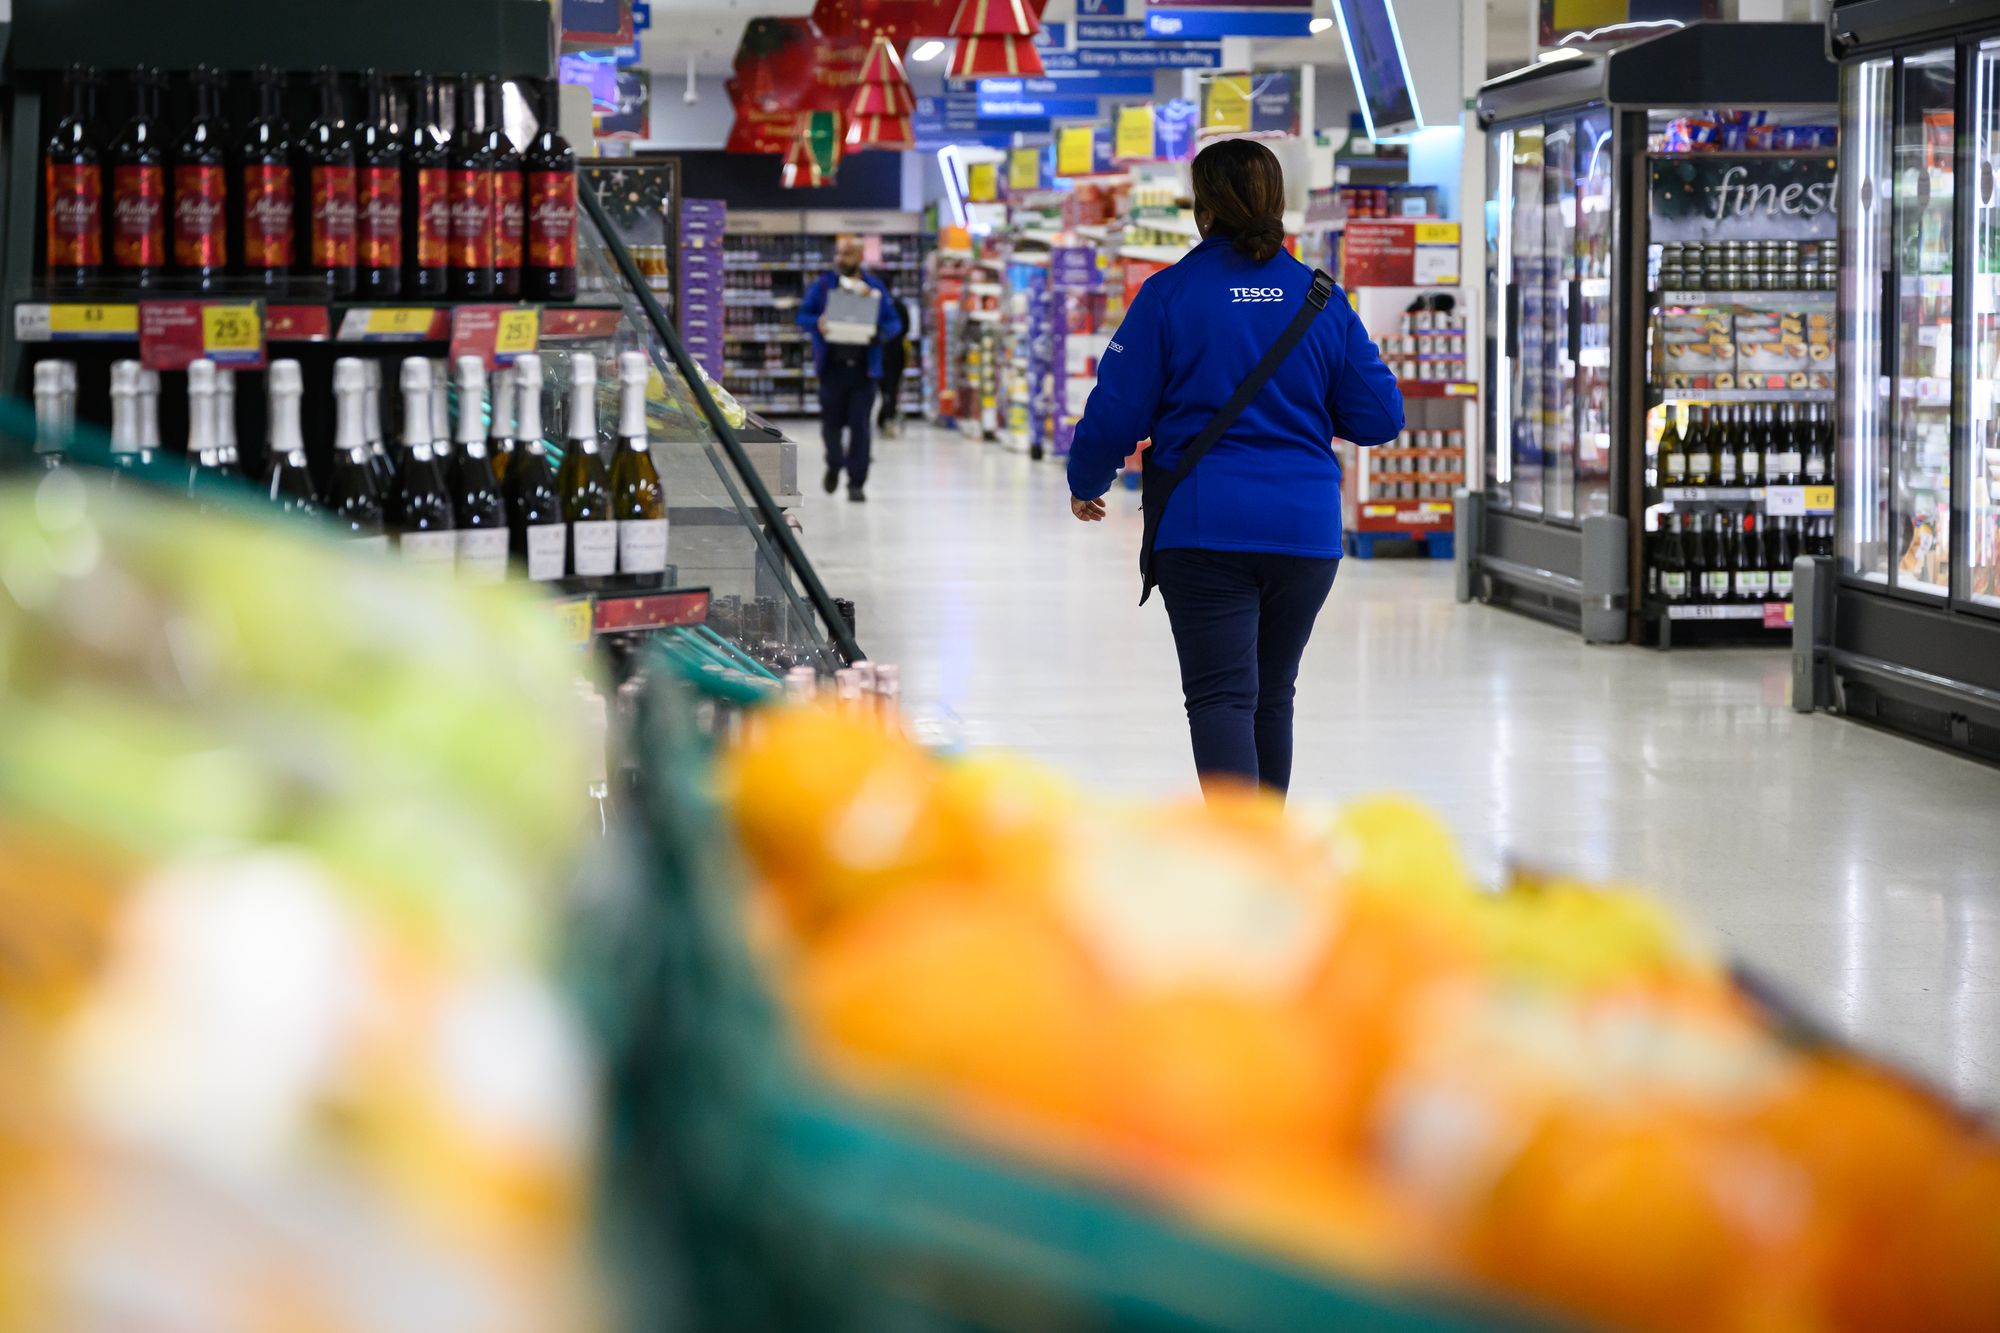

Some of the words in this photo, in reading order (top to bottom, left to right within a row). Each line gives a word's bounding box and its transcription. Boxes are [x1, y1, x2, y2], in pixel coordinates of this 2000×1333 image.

[1150, 14, 1183, 34] Eggs
[1713, 165, 1838, 220] finest
[1230, 288, 1284, 298] TESCO
